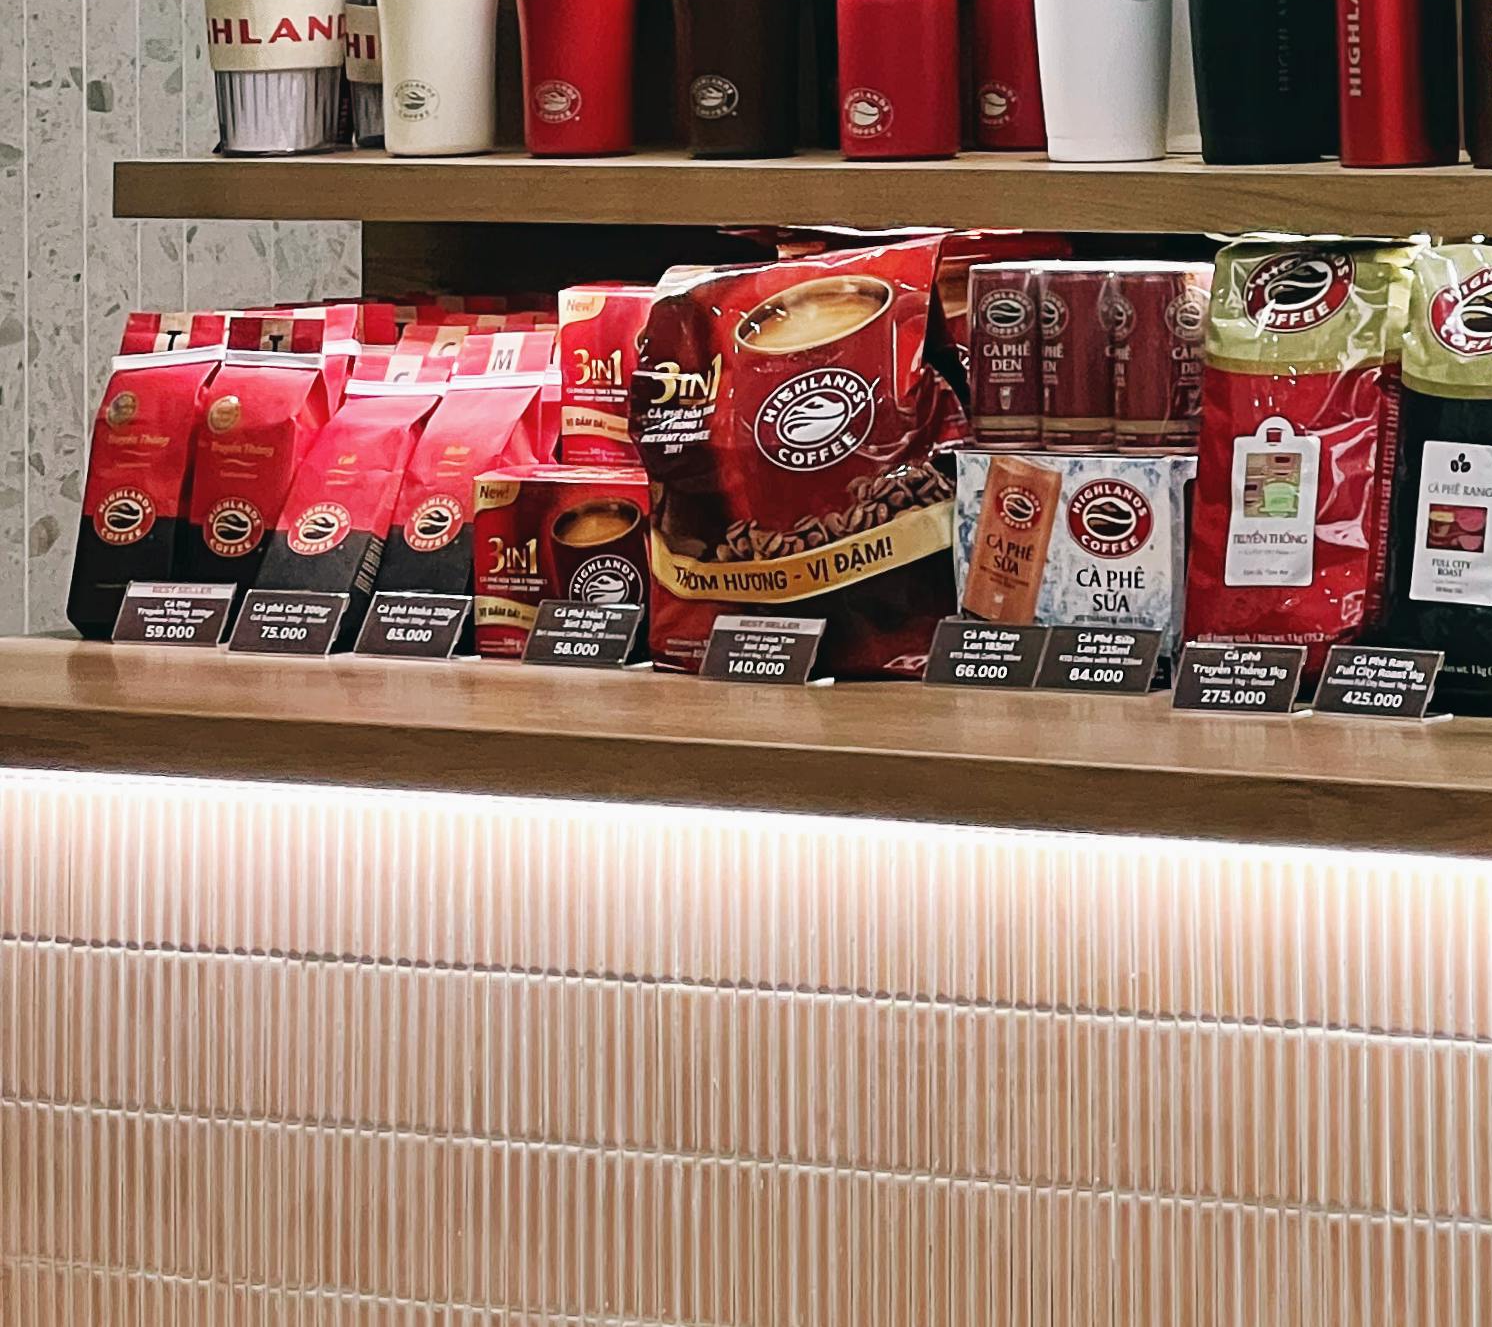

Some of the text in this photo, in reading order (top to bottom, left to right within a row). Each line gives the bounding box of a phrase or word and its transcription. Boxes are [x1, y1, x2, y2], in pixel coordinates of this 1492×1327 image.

[566, 299, 595, 312] New!
[1254, 301, 1330, 327] OFFEE
[983, 341, 1031, 357] CÀ PHÊ
[491, 349, 514, 371] M
[763, 374, 867, 423] HIGHLANDS
[778, 431, 858, 465] COFFEE
[480, 486, 510, 499] New!
[1428, 484, 1440, 493] CÀ
[99, 489, 153, 514] HIGHLANDS
[1072, 484, 1148, 516] HIGHLANDS
[208, 499, 261, 523] HIGHLANDS
[295, 504, 350, 527] HIGHLANDS
[411, 497, 462, 522] HIGHLANDS
[101, 527, 142, 542] COFFEE
[409, 534, 449, 548] COFFEE
[209, 538, 252, 554] COFFEE
[292, 538, 334, 552] COFFEE
[986, 533, 1034, 561] CÀ PHÊ
[1081, 534, 1139, 554] COFFEE
[488, 537, 538, 575] 3IN1
[674, 565, 718, 590] THƠM
[724, 570, 788, 591] HƯƠNG
[807, 558, 830, 582] VỊ
[834, 536, 893, 572] ĐẬM!
[1432, 558, 1471, 569] FULL CITY
[573, 559, 635, 594] HIGHLANDS
[1076, 564, 1146, 589] CÀ PHÊ
[253, 603, 266, 612] Cà
[1092, 589, 1130, 613] SỮA
[145, 625, 195, 639] 59.000
[260, 626, 307, 640] 75.000
[963, 629, 977, 640] Cà
[1078, 632, 1092, 643] Cà
[553, 641, 599, 656] 58.000
[1077, 644, 1097, 654] Lon
[728, 660, 784, 675] 140.000
[955, 664, 1008, 679] 66.000
[1069, 667, 1124, 683] 84.000
[1335, 665, 1356, 676] Full
[1358, 666, 1377, 679] City
[1200, 689, 1266, 705] 275.000
[1342, 691, 1403, 708] 425.000
